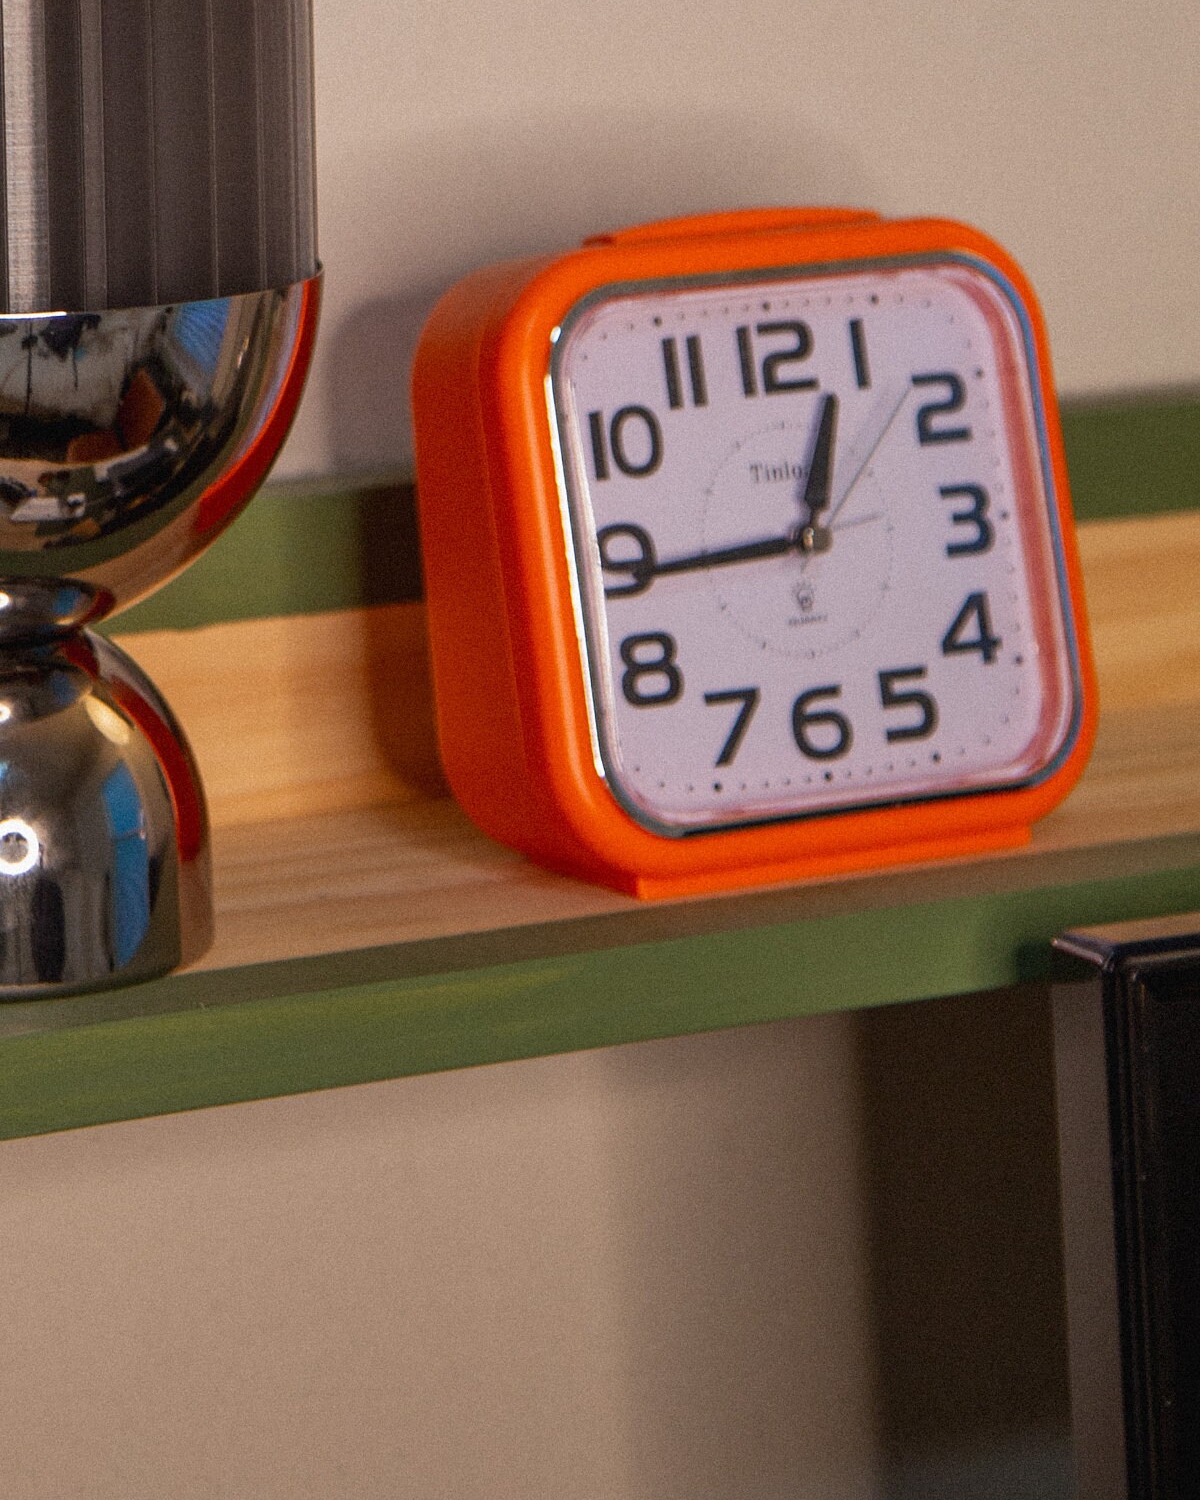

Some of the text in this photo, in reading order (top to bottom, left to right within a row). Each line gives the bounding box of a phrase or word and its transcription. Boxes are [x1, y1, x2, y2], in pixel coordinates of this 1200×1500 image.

[661, 335, 708, 410] 11
[735, 319, 819, 398] 12
[848, 318, 871, 390] 1
[588, 404, 664, 482] 10
[911, 371, 972, 447] 2
[938, 483, 996, 558] 3
[596, 523, 657, 600] 9
[940, 591, 1002, 666] 4
[619, 631, 684, 708] 8
[877, 665, 939, 744] 5
[703, 687, 761, 768] 7
[791, 684, 854, 762] 6
